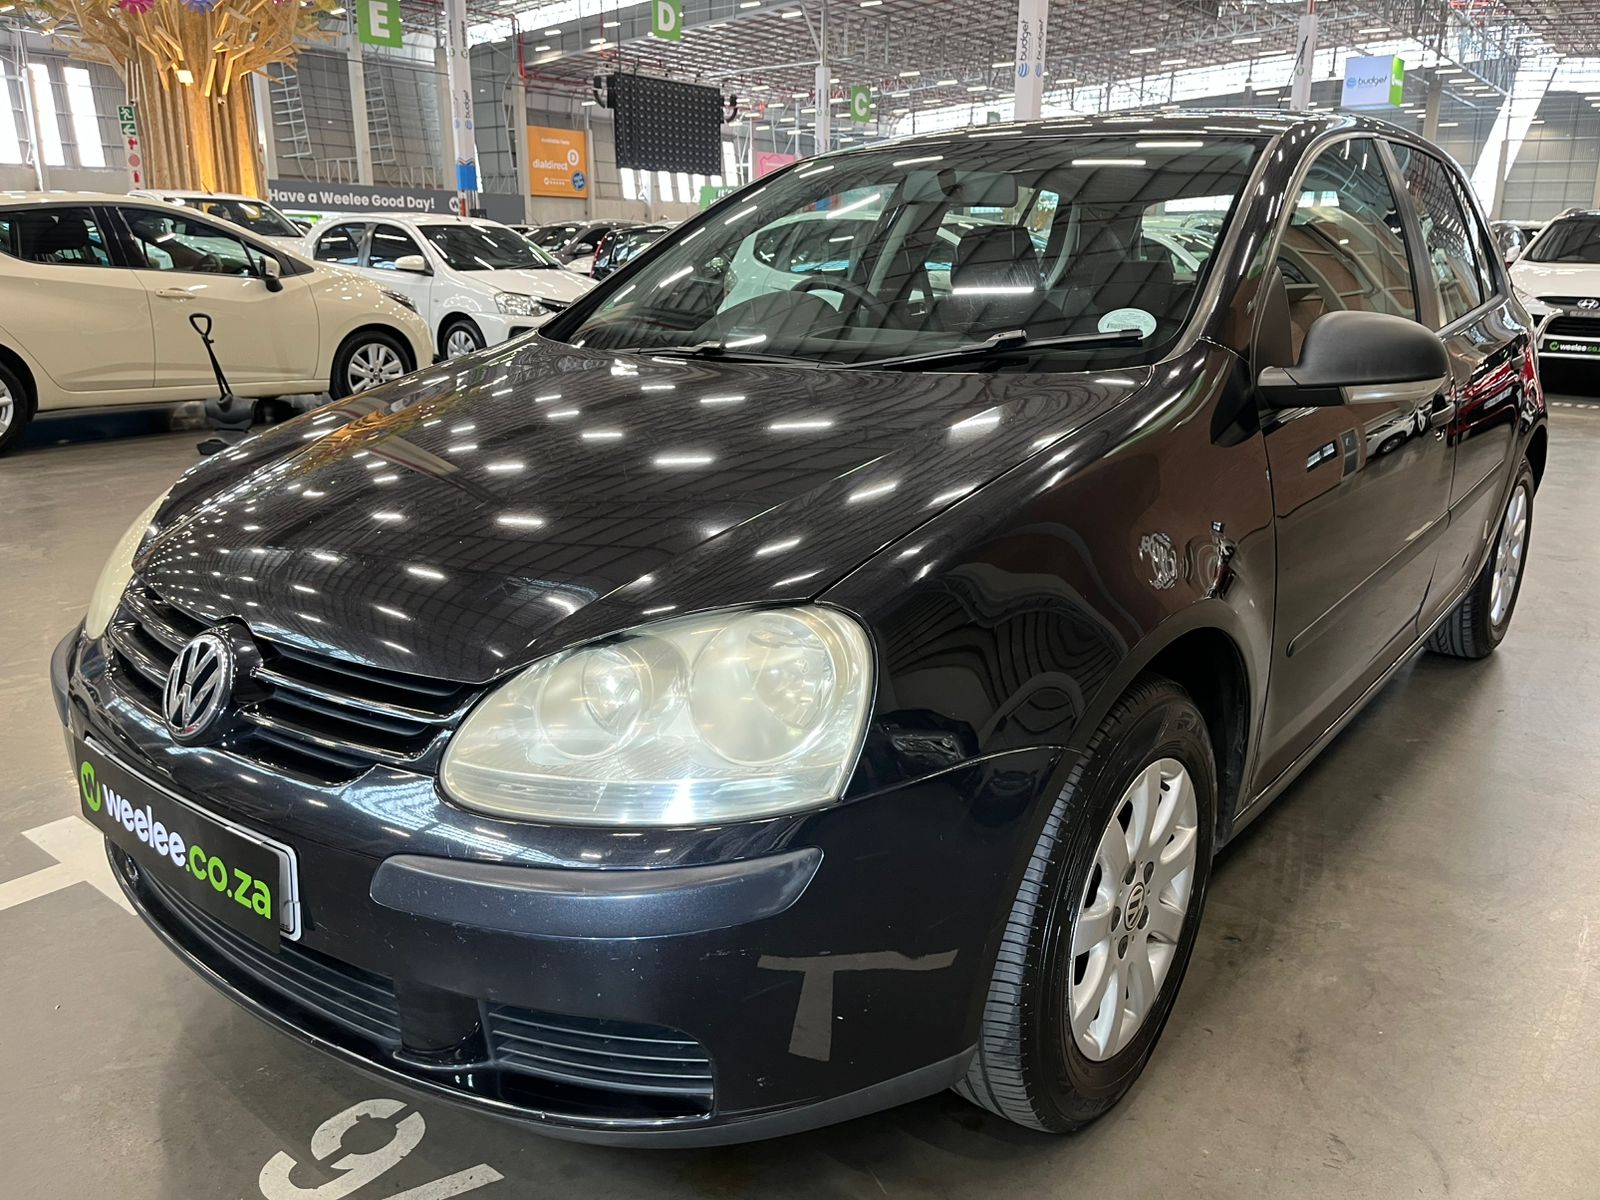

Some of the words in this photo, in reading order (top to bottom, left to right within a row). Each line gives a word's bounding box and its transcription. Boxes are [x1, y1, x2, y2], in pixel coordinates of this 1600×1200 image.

[369, 1, 390, 38] E
[658, 1, 675, 31] D
[1020, 18, 1031, 61] budget
[1358, 75, 1388, 87] budget
[855, 93, 867, 116] C
[533, 159, 568, 171] dialdirect
[269, 189, 305, 203] Have
[308, 194, 317, 203] a
[319, 191, 369, 206] Weelee
[372, 195, 404, 208] Good
[406, 197, 435, 212] Day!
[102, 783, 272, 920] weelee.co.za
